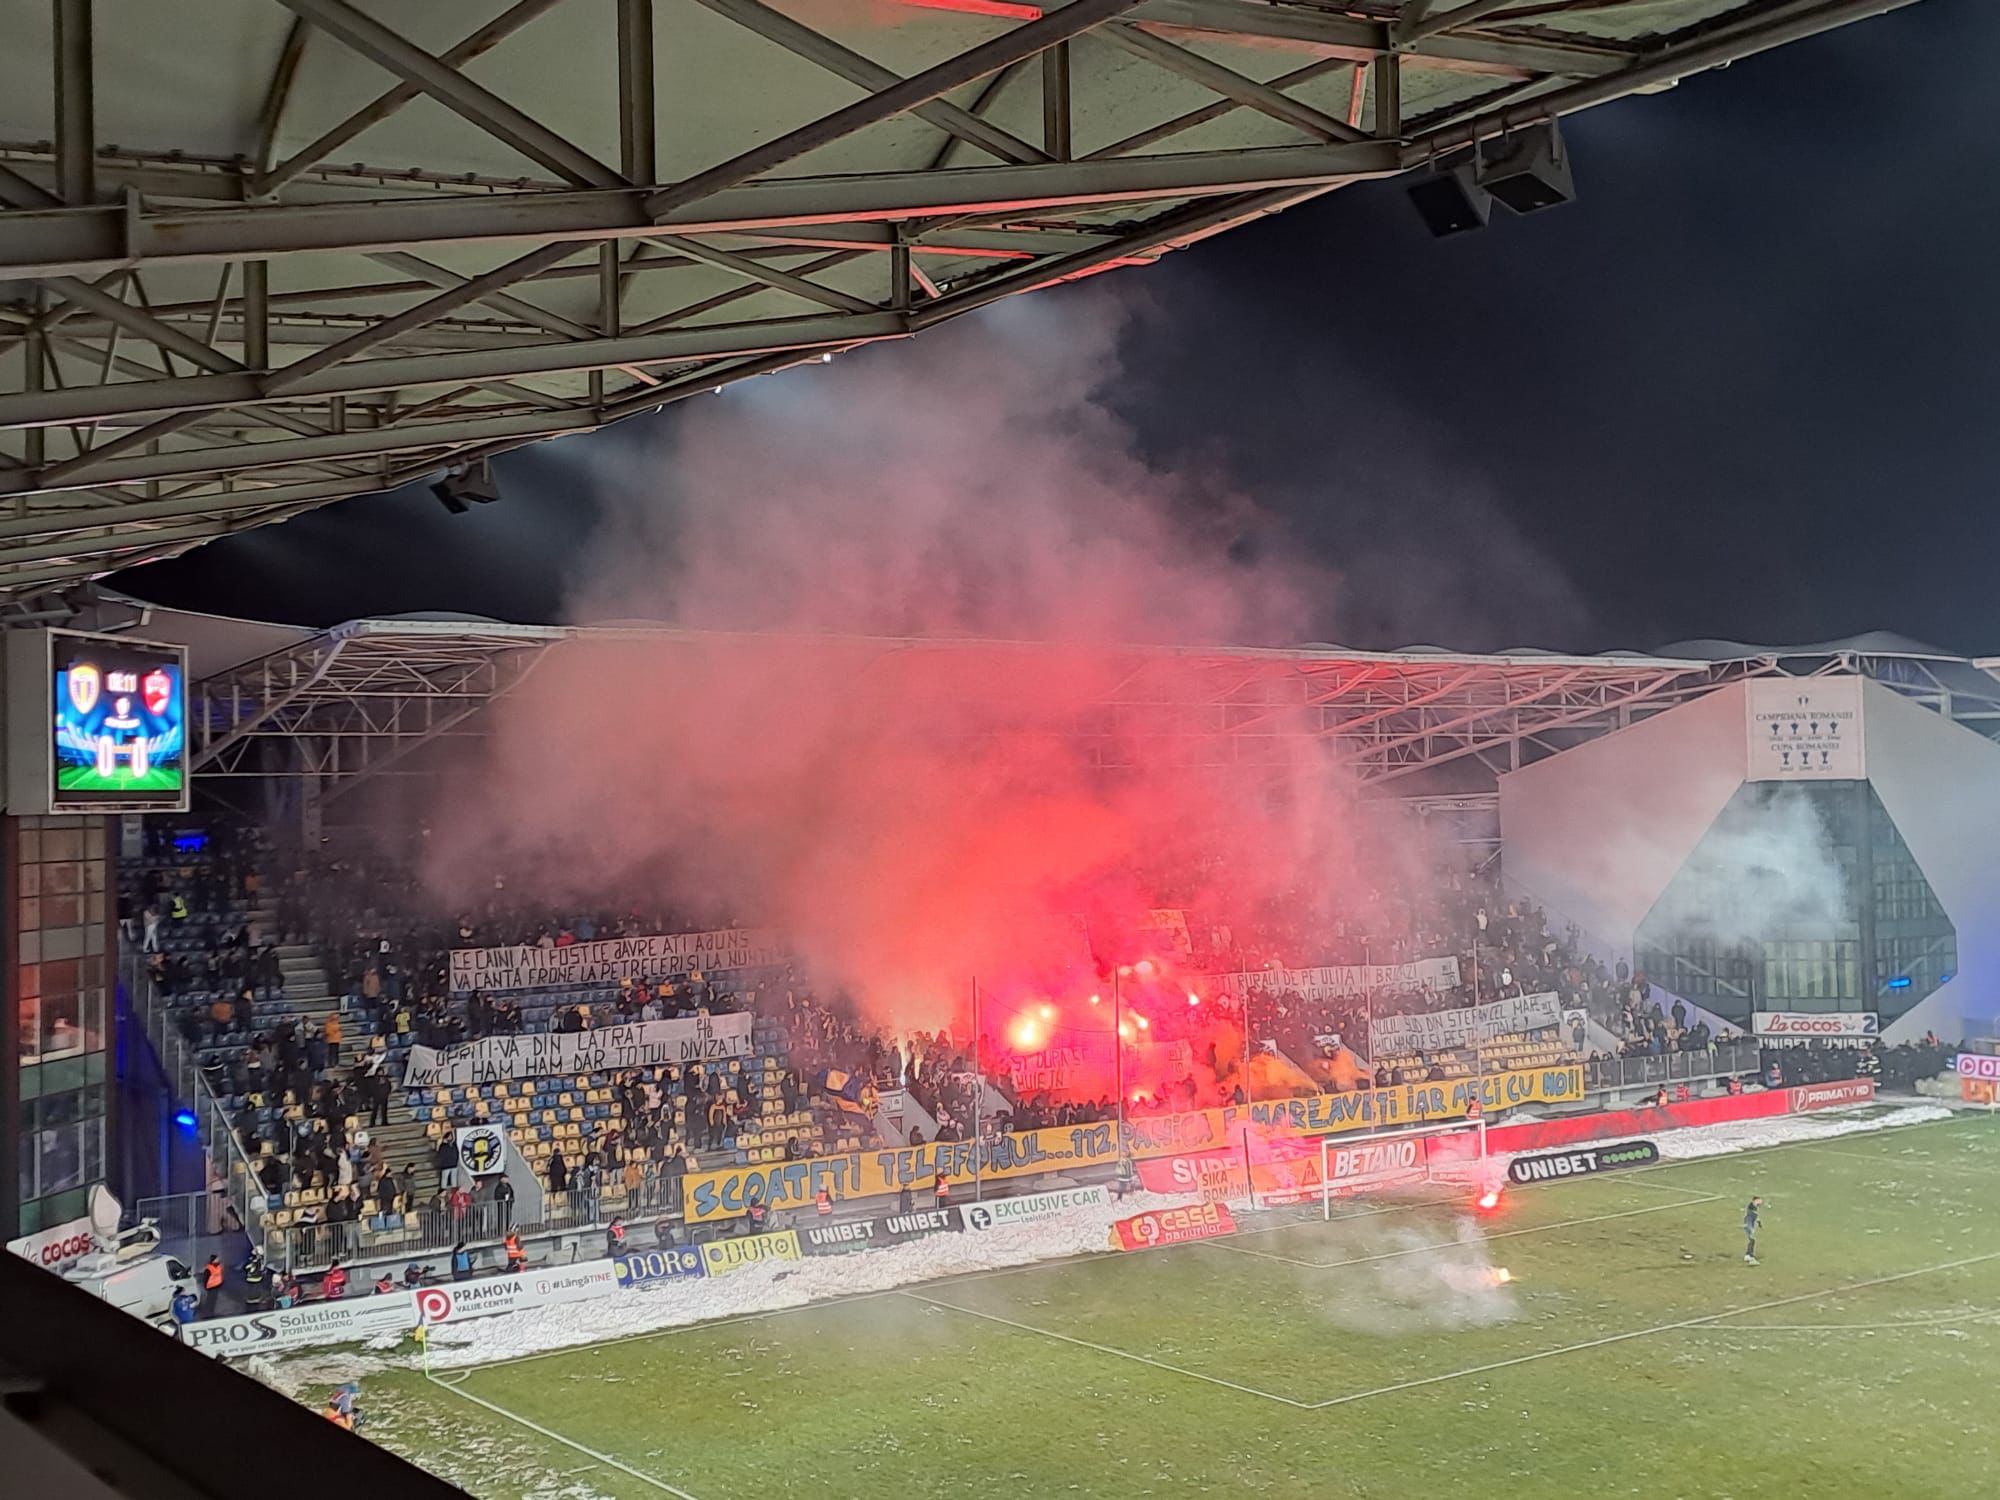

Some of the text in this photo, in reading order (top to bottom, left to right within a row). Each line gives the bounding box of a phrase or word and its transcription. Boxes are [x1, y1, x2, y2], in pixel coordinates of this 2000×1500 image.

[452, 951, 472, 970] CE
[453, 972, 471, 989] VA
[580, 965, 597, 982] LA
[1862, 1014, 1877, 1034] 2
[533, 1034, 561, 1057] DIN
[577, 1023, 647, 1051] LATRAT
[471, 1059, 513, 1082] HAM
[525, 1055, 563, 1076] HAM
[573, 1049, 606, 1072] DAR
[1506, 1072, 1534, 1102] CU
[1334, 1141, 1417, 1178] BETANO
[1513, 1153, 1598, 1182] UNIBET
[994, 1193, 1071, 1218] EXCLUSIVE
[808, 1210, 949, 1245] UNIBET UNIBET
[453, 1281, 524, 1303] PRAHOVA
[279, 1308, 351, 1329] Solution
